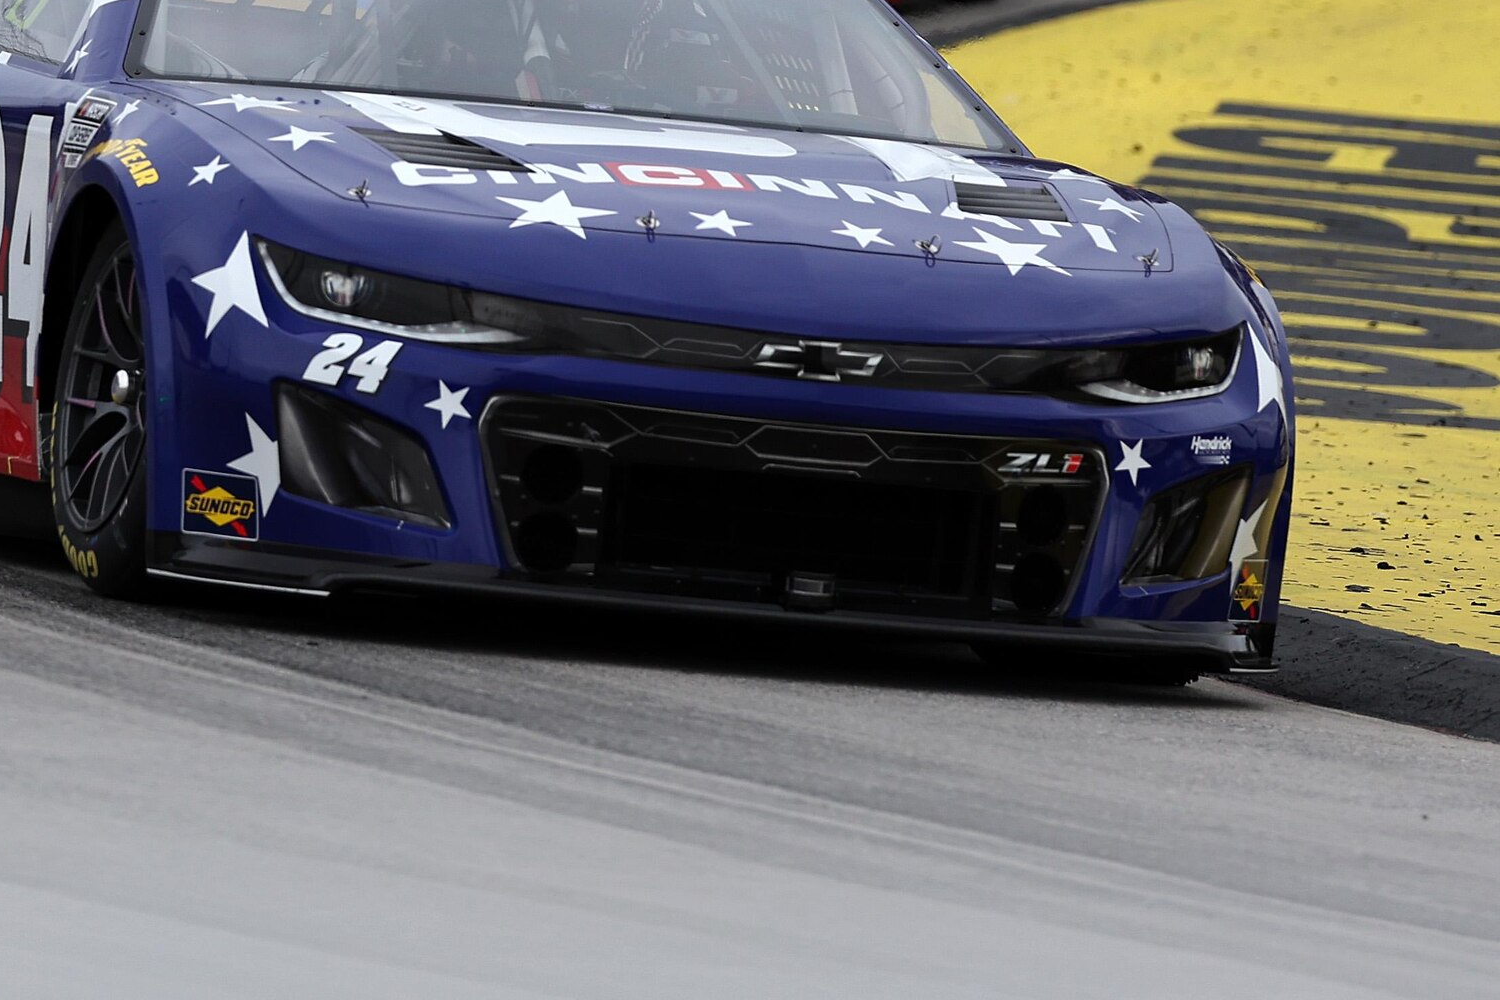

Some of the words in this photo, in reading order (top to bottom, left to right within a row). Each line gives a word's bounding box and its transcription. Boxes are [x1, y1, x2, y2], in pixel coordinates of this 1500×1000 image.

[302, 332, 404, 394] 24
[997, 453, 1084, 473] ZL1
[188, 496, 252, 517] SUNOCO
